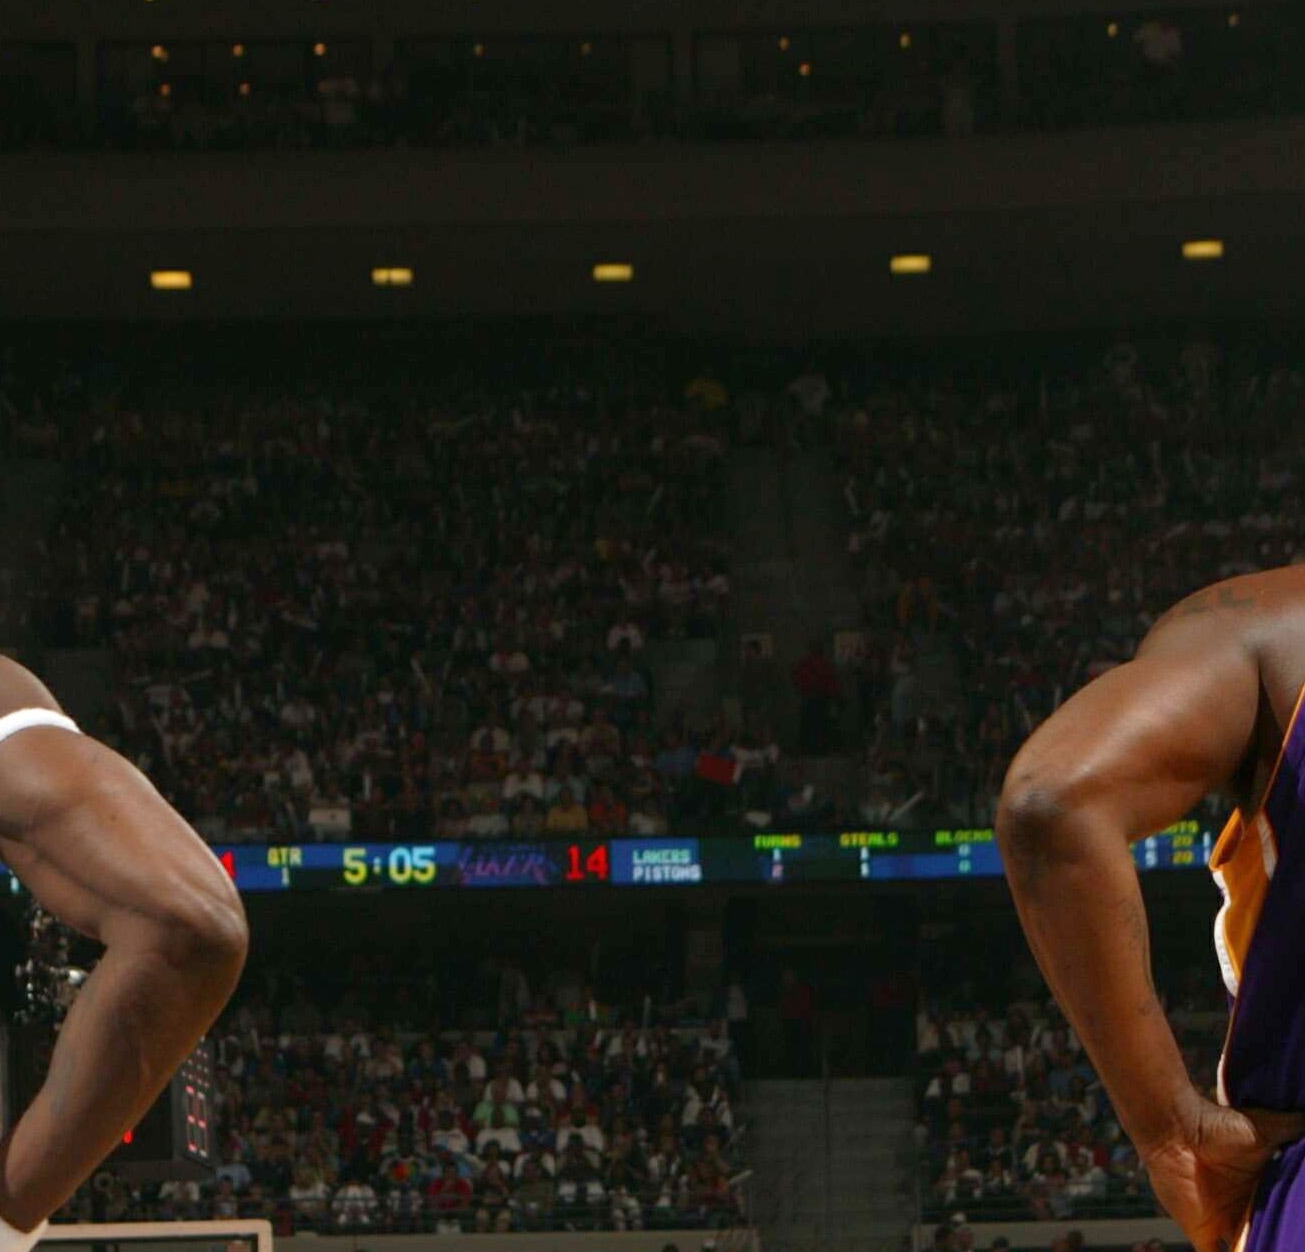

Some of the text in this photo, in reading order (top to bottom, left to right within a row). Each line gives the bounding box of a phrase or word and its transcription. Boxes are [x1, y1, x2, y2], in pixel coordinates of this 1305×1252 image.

[840, 832, 898, 847] STEALS
[343, 846, 436, 884] 5:05
[565, 844, 608, 881] 14
[632, 864, 703, 882] PISTONS
